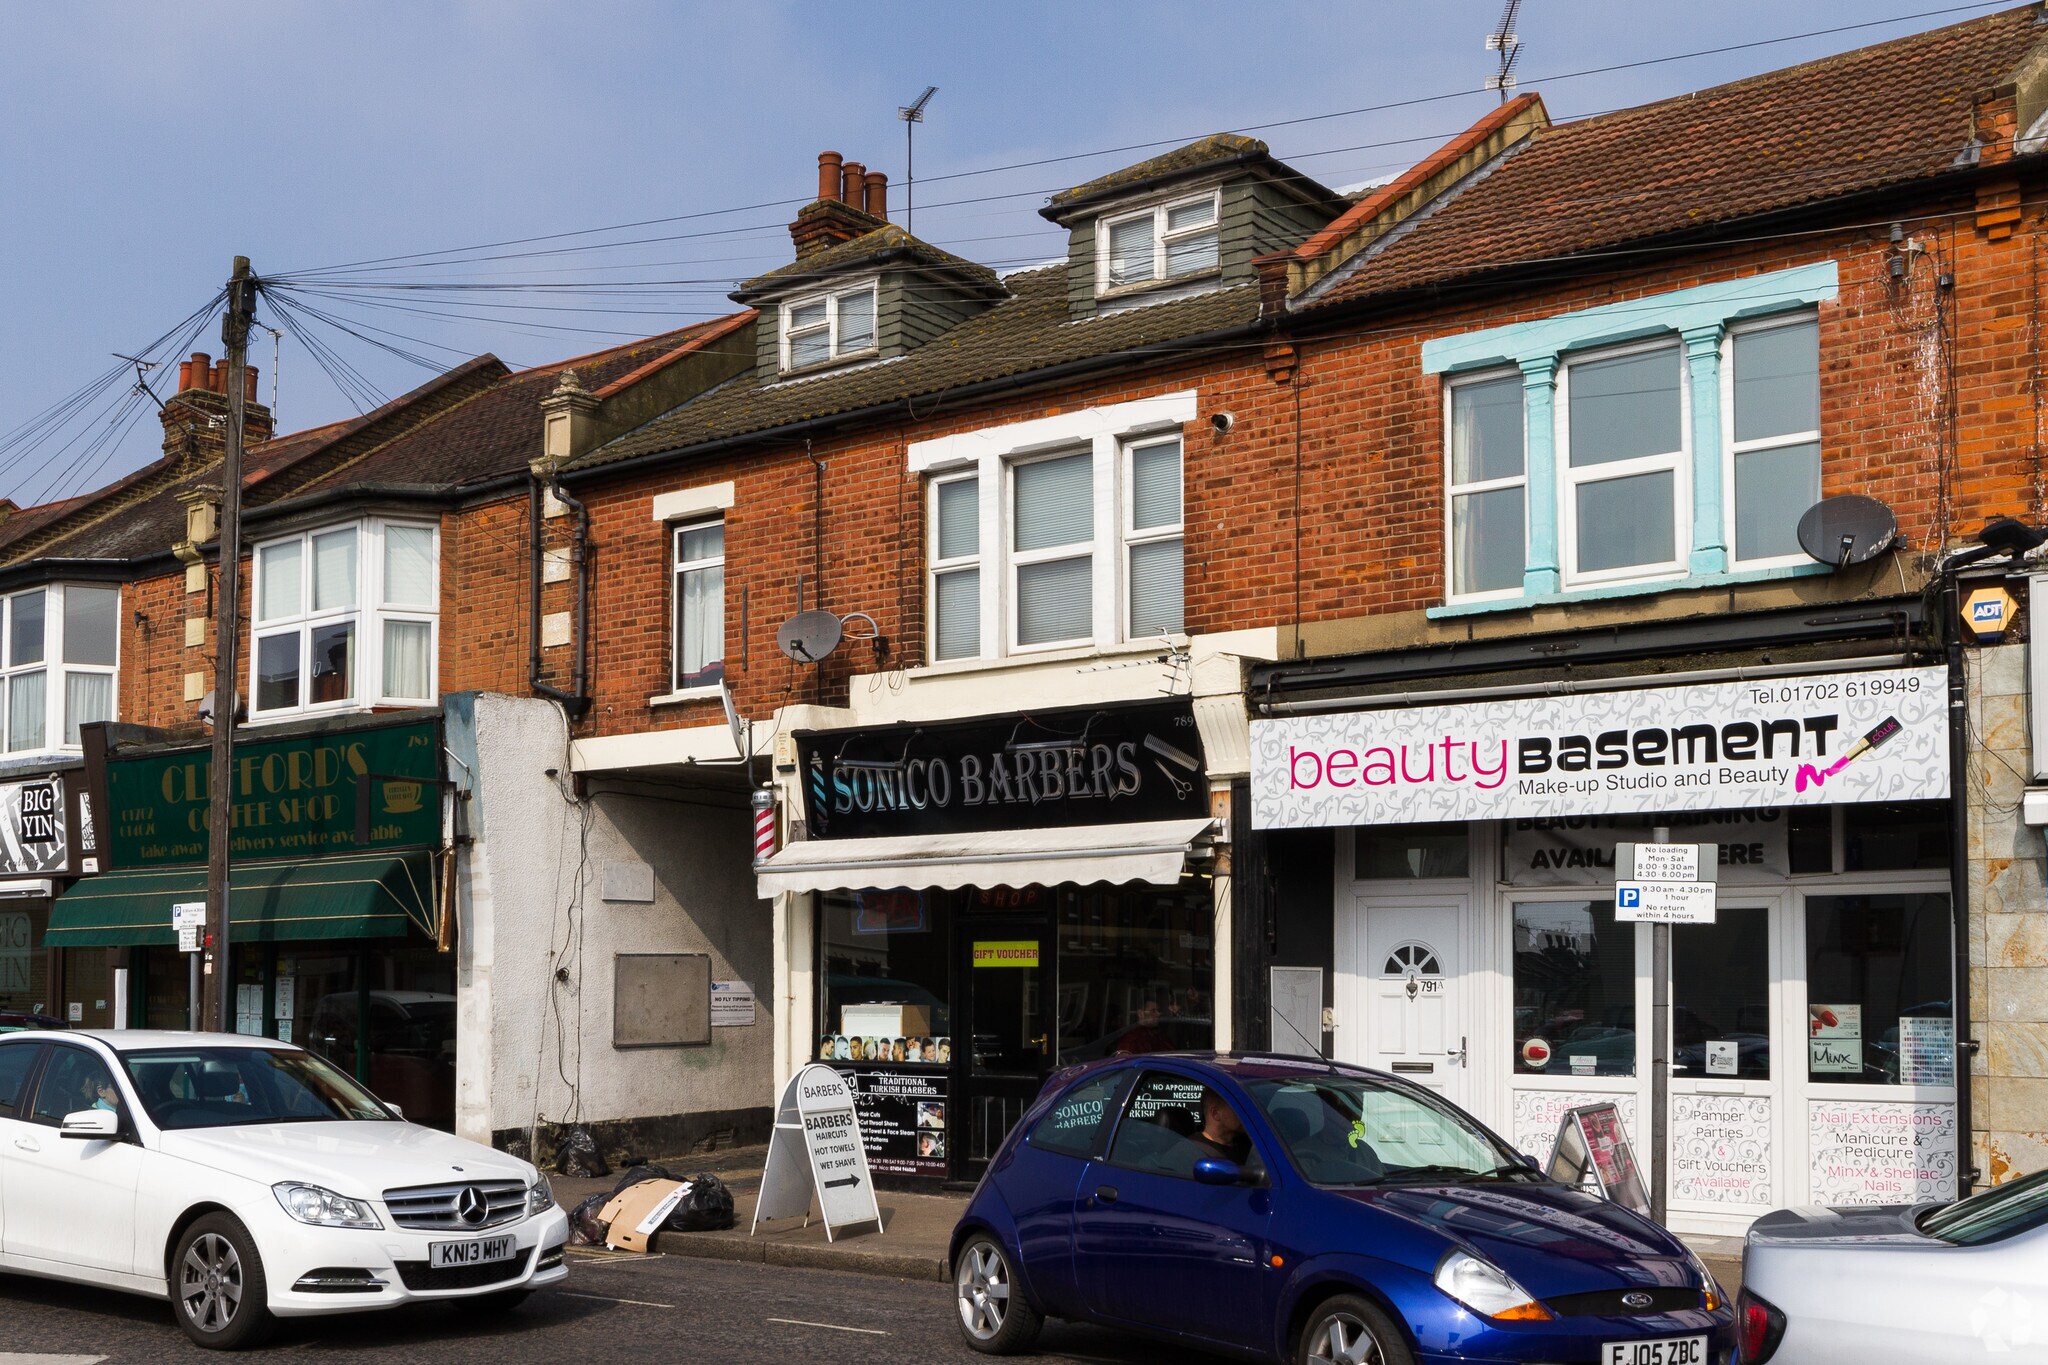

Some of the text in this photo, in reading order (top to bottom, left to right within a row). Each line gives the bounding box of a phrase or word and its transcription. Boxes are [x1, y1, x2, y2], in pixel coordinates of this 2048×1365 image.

[1974, 604, 2001, 618] ADT
[1846, 677, 1920, 698] 619949
[1174, 715, 1194, 727] 789
[1872, 720, 1897, 744] .co.uk
[1289, 735, 1507, 789] beauty
[161, 742, 368, 804] CLIFORD'S
[832, 742, 1142, 814] SONICO BARBERS
[1518, 766, 1789, 796] Make-up Studio and Beauty
[23, 788, 52, 812] BIG
[188, 795, 340, 832] CFEE SHOP
[1642, 807, 1781, 828] TRAINING
[22, 814, 54, 837] YIN
[141, 844, 168, 858] take
[171, 842, 204, 856] away
[230, 837, 275, 851] elivery
[280, 831, 328, 848] service
[1659, 846, 1688, 854] loading
[1717, 843, 1764, 866] ERE
[980, 888, 1037, 906] SHOP
[1623, 890, 1638, 906] P
[0, 917, 27, 948] IG
[974, 948, 1039, 959] GIFT VOUCHER
[0, 957, 28, 988] IN
[879, 1077, 927, 1086] TRADITIONAL
[1152, 1083, 1205, 1092] NO APPOINTME
[804, 1083, 844, 1099] BARBERS
[869, 1085, 937, 1095] TURKISH BARBERS
[1055, 1100, 1101, 1120] SONICO
[1129, 1109, 1155, 1118] RKISH
[1693, 1110, 1745, 1123] Pamper
[805, 1113, 853, 1130] BARBERS
[1820, 1113, 1943, 1126] Nail Extensions
[815, 1129, 848, 1141] HAIRCUTS
[1696, 1127, 1744, 1138] Parties
[1835, 1132, 1923, 1146] Manicure &
[814, 1143, 856, 1156] HOT TOWELS
[1717, 1146, 1725, 1156] &
[1845, 1146, 1914, 1159] Pedicure
[819, 1158, 857, 1170] WET SHAVE
[1678, 1159, 1767, 1173] Gift Vouchers
[1828, 1166, 1939, 1180] Minx & Shellac
[1694, 1177, 1750, 1188] Available
[1864, 1180, 1902, 1192] Nails
[443, 1239, 509, 1263] KN13 MHY
[1631, 1295, 1648, 1304] Ford
[1668, 1339, 1700, 1364] ZBC
